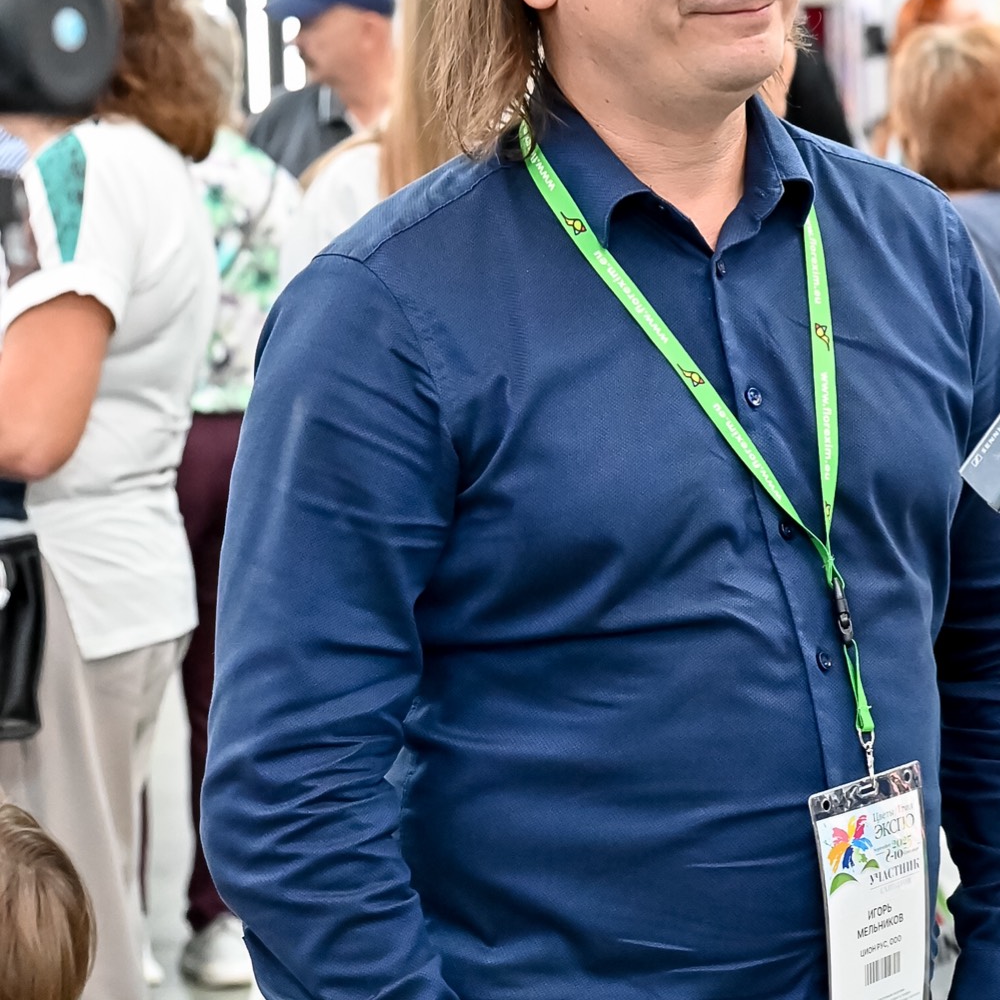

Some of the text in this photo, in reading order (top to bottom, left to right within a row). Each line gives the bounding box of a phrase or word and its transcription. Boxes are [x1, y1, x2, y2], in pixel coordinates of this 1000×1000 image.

[593, 250, 669, 344] www.florexim.eu
[820, 371, 833, 481] www.florexim.eu
[712, 402, 782, 501] www.florexim.eu
[874, 813, 915, 840] ЭКСПО
[869, 857, 920, 886] УЧАСТНИК
[856, 912, 904, 940] МЕЛЬНИКОВ
[867, 903, 893, 921] ИГОРЬ
[889, 934, 903, 946] ООО
